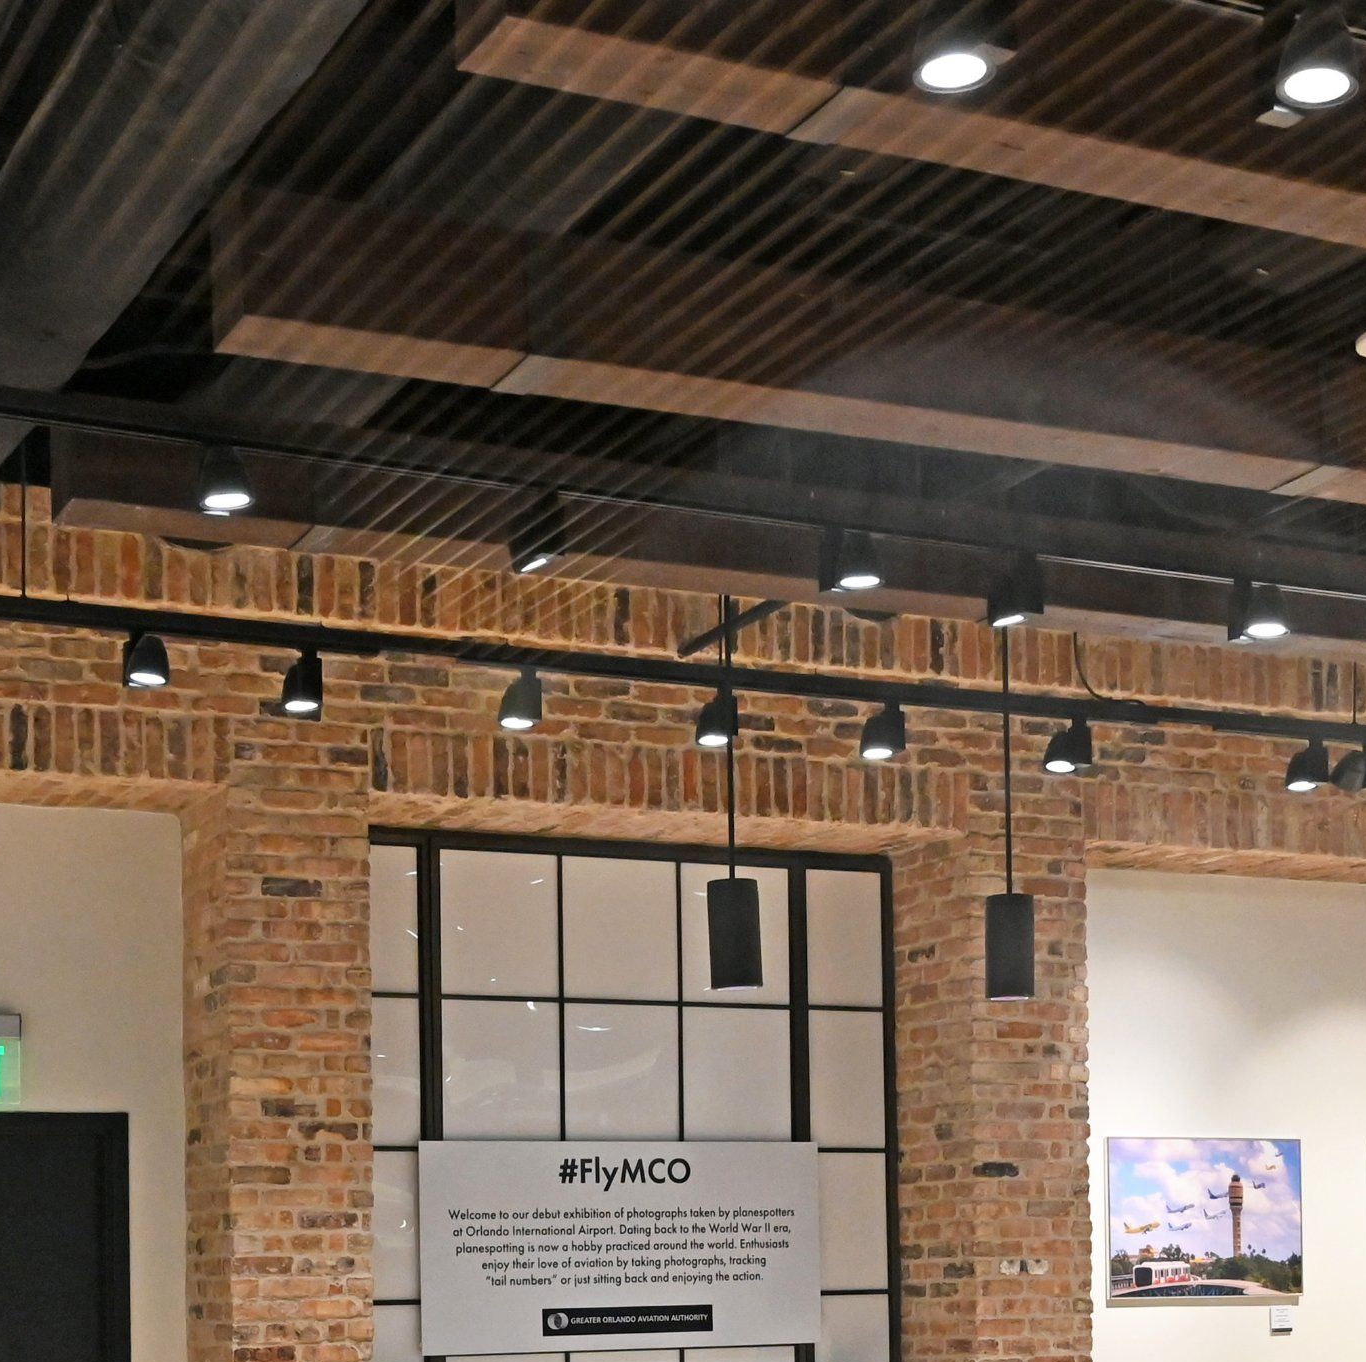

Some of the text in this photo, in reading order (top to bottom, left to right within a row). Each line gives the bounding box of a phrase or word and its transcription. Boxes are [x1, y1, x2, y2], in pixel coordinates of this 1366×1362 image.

[559, 1156, 691, 1192] #FlyMCO
[448, 1209, 496, 1220] Welcome
[499, 1210, 509, 1219] to
[532, 1208, 560, 1219] debut
[563, 1207, 611, 1219] exhibition
[614, 1207, 624, 1218] of
[627, 1207, 687, 1221] photographs
[690, 1206, 715, 1217] taken
[719, 1206, 730, 1220] by
[733, 1206, 794, 1220] planespotters
[453, 1228, 463, 1237] at
[466, 1225, 509, 1237] Orlando
[513, 1224, 575, 1236] International
[578, 1224, 616, 1237] Airport.
[619, 1224, 651, 1237] Dating
[654, 1223, 677, 1234] back
[680, 1225, 689, 1234] to
[692, 1223, 706, 1233] the
[709, 1222, 738, 1234] World
[741, 1223, 762, 1233] War
[773, 1226, 791, 1234] era,
[456, 1242, 524, 1256] planespotting
[528, 1242, 535, 1252] is
[572, 1240, 602, 1254] hobby
[606, 1240, 650, 1254] practiced
[653, 1239, 687, 1250] around
[690, 1239, 704, 1249] the
[707, 1238, 737, 1249] world.
[740, 1238, 789, 1249] Enthusiasts
[482, 1254, 766, 1273] enjoy their love of aviation by taking photographs, tracking
[561, 1277, 571, 1285] or
[574, 1274, 590, 1287] just
[594, 1274, 621, 1286] sitting
[625, 1272, 648, 1283] back
[651, 1272, 669, 1283] and
[672, 1271, 713, 1285] enjoying
[716, 1270, 729, 1281] the
[733, 1271, 763, 1281] action.
[571, 1313, 708, 1325] GREATER ORLANDO AVIATION AUTHORITY
